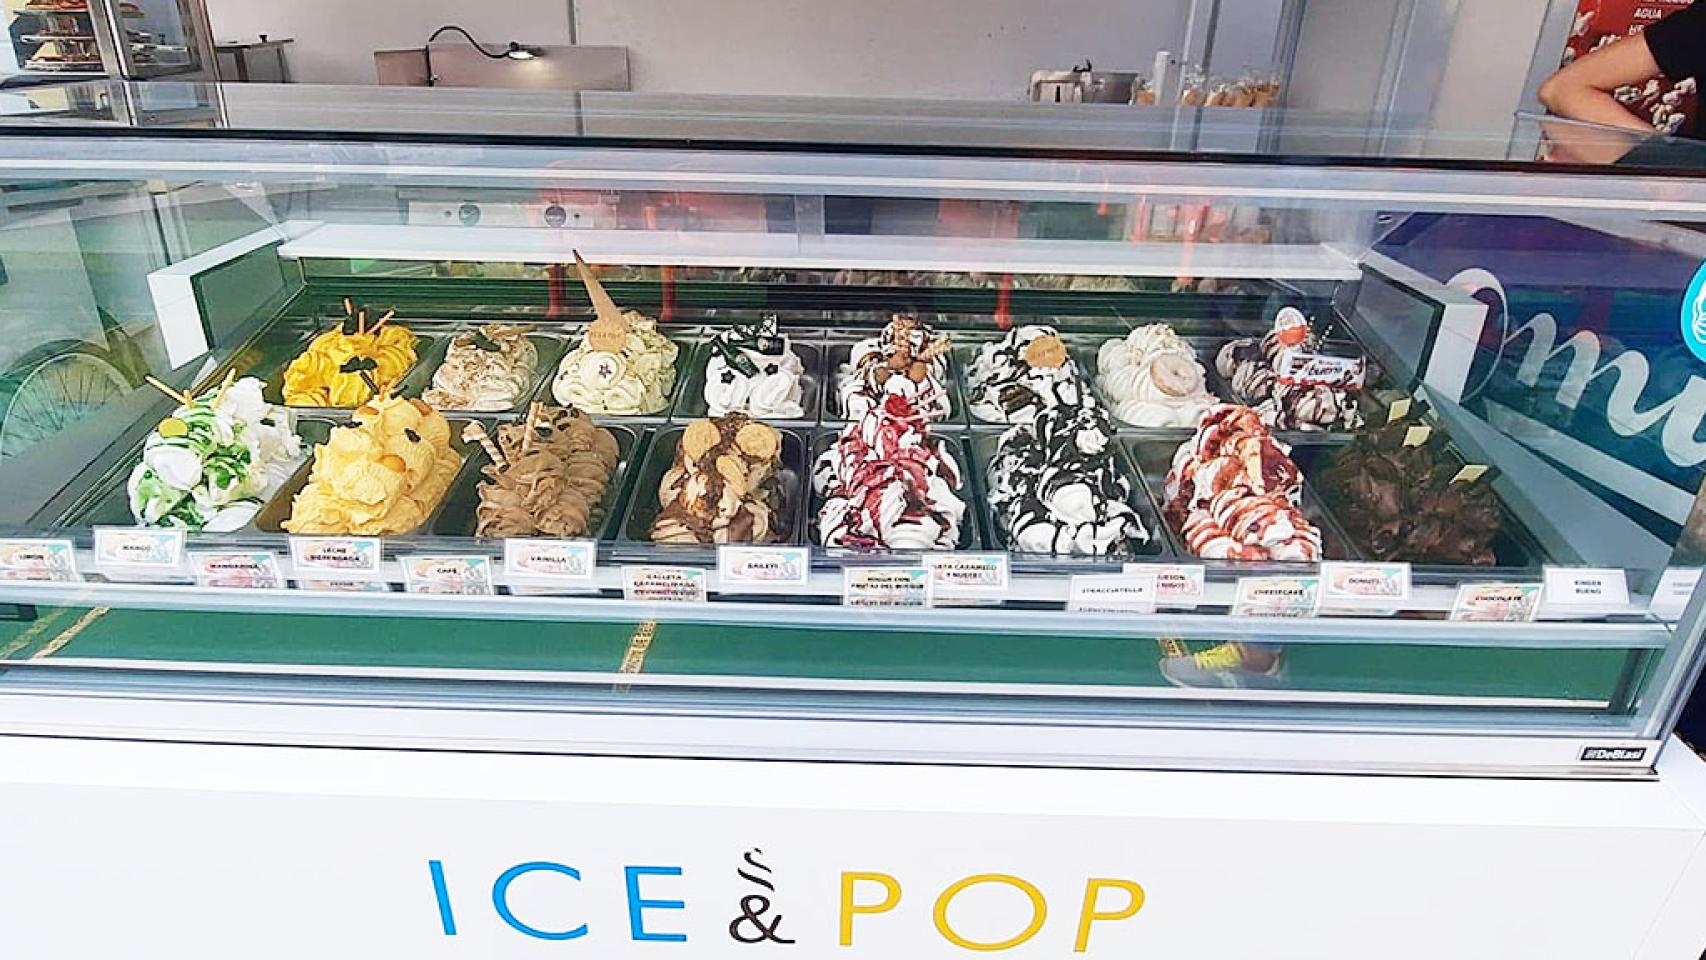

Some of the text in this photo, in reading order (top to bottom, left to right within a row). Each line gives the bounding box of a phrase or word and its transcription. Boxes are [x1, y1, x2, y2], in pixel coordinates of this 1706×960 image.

[1633, 8, 1662, 19] AGUA
[428, 859, 688, 943] ICE
[838, 870, 1147, 954] POP
